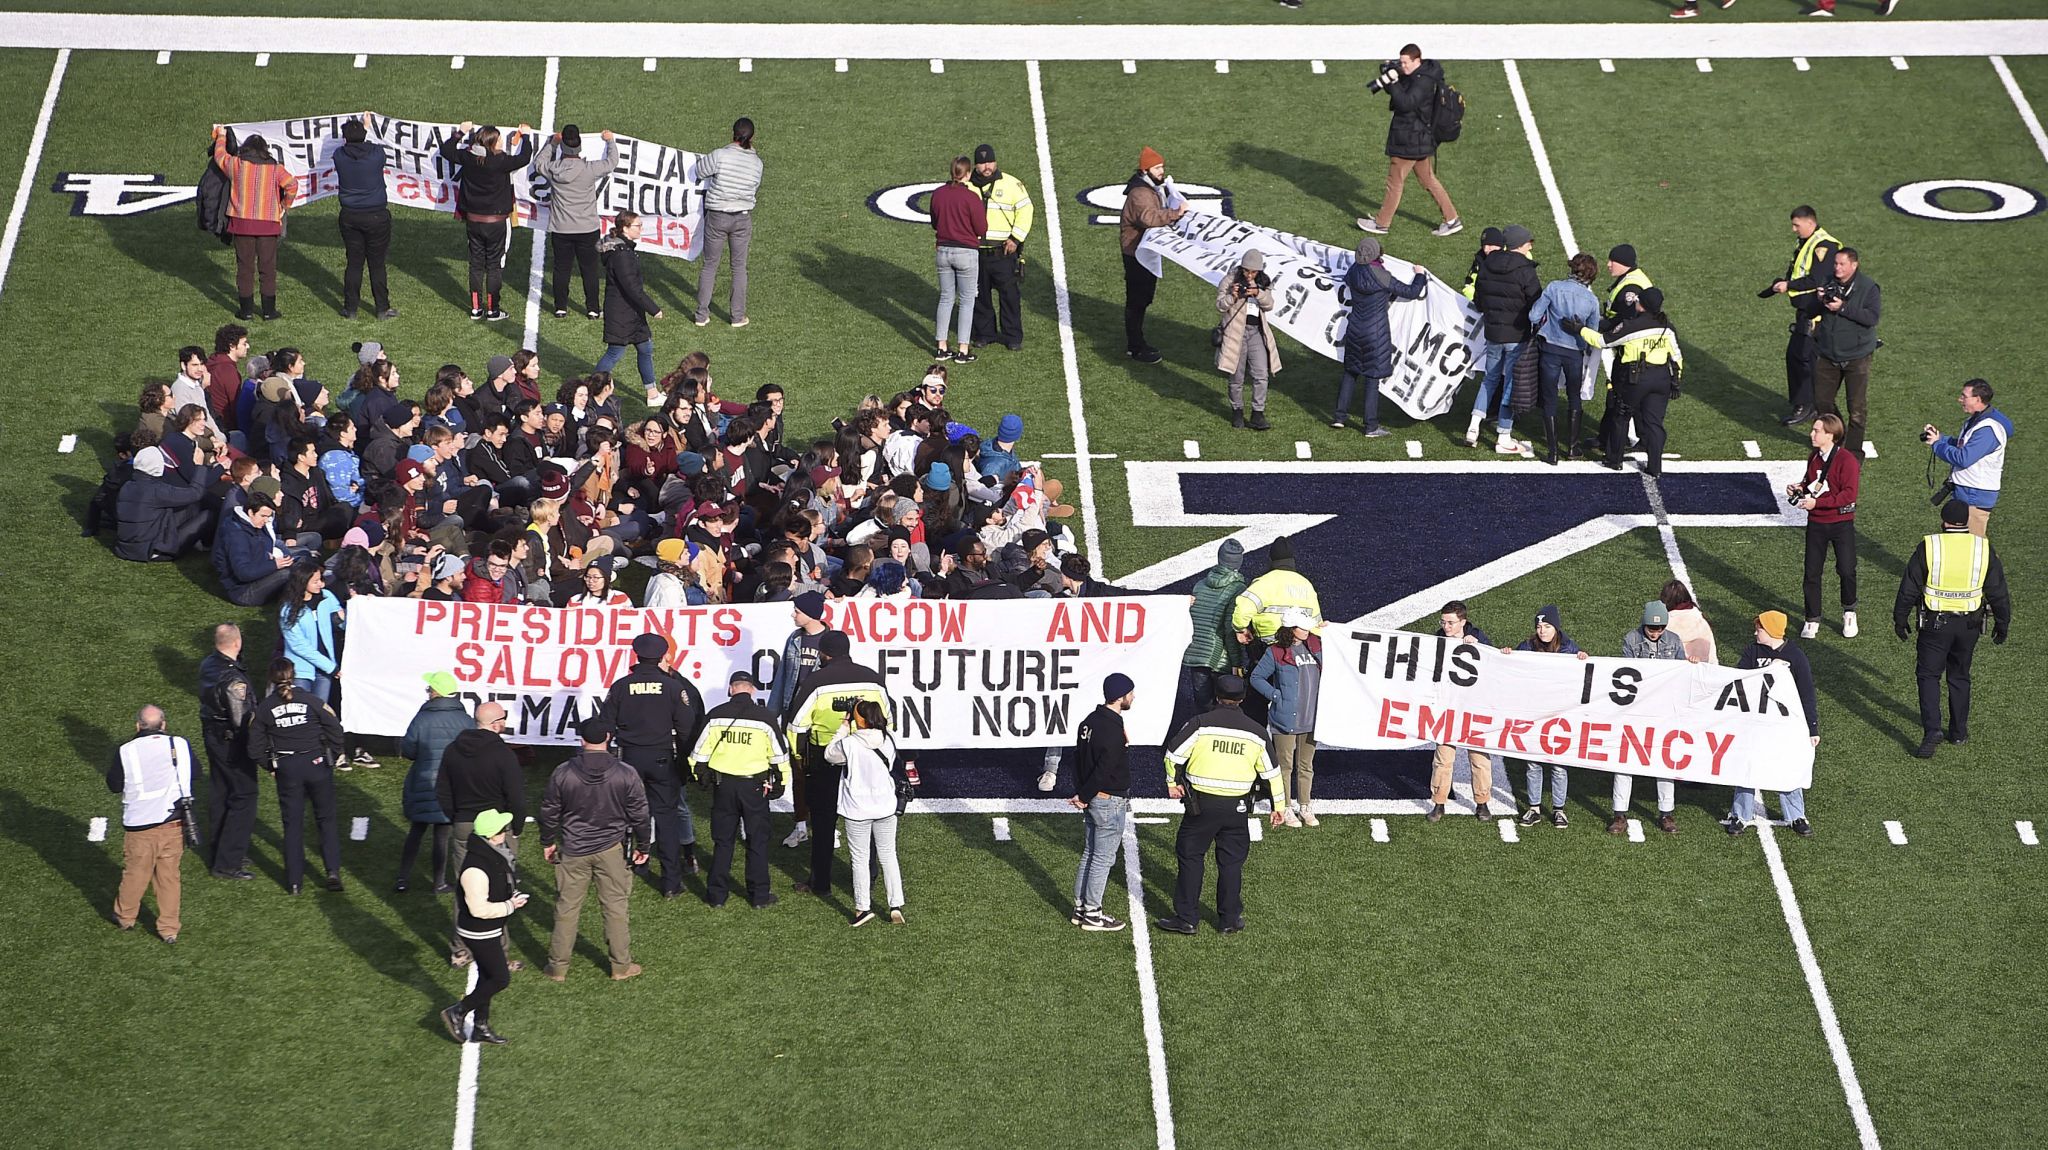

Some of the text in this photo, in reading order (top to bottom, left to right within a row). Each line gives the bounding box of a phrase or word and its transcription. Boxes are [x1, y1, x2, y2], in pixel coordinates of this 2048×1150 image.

[415, 600, 743, 647] PRESIDENTS
[1046, 602, 1146, 644] AND
[629, 682, 663, 695] POLICE
[878, 649, 1080, 692] FUTURE
[1351, 632, 1481, 687] THIS
[1581, 663, 1643, 706] IS
[973, 694, 1069, 738] NOW
[1378, 698, 1735, 776] EMERGENCY
[720, 731, 753, 746] POLICE
[1212, 738, 1246, 756] POLICE
